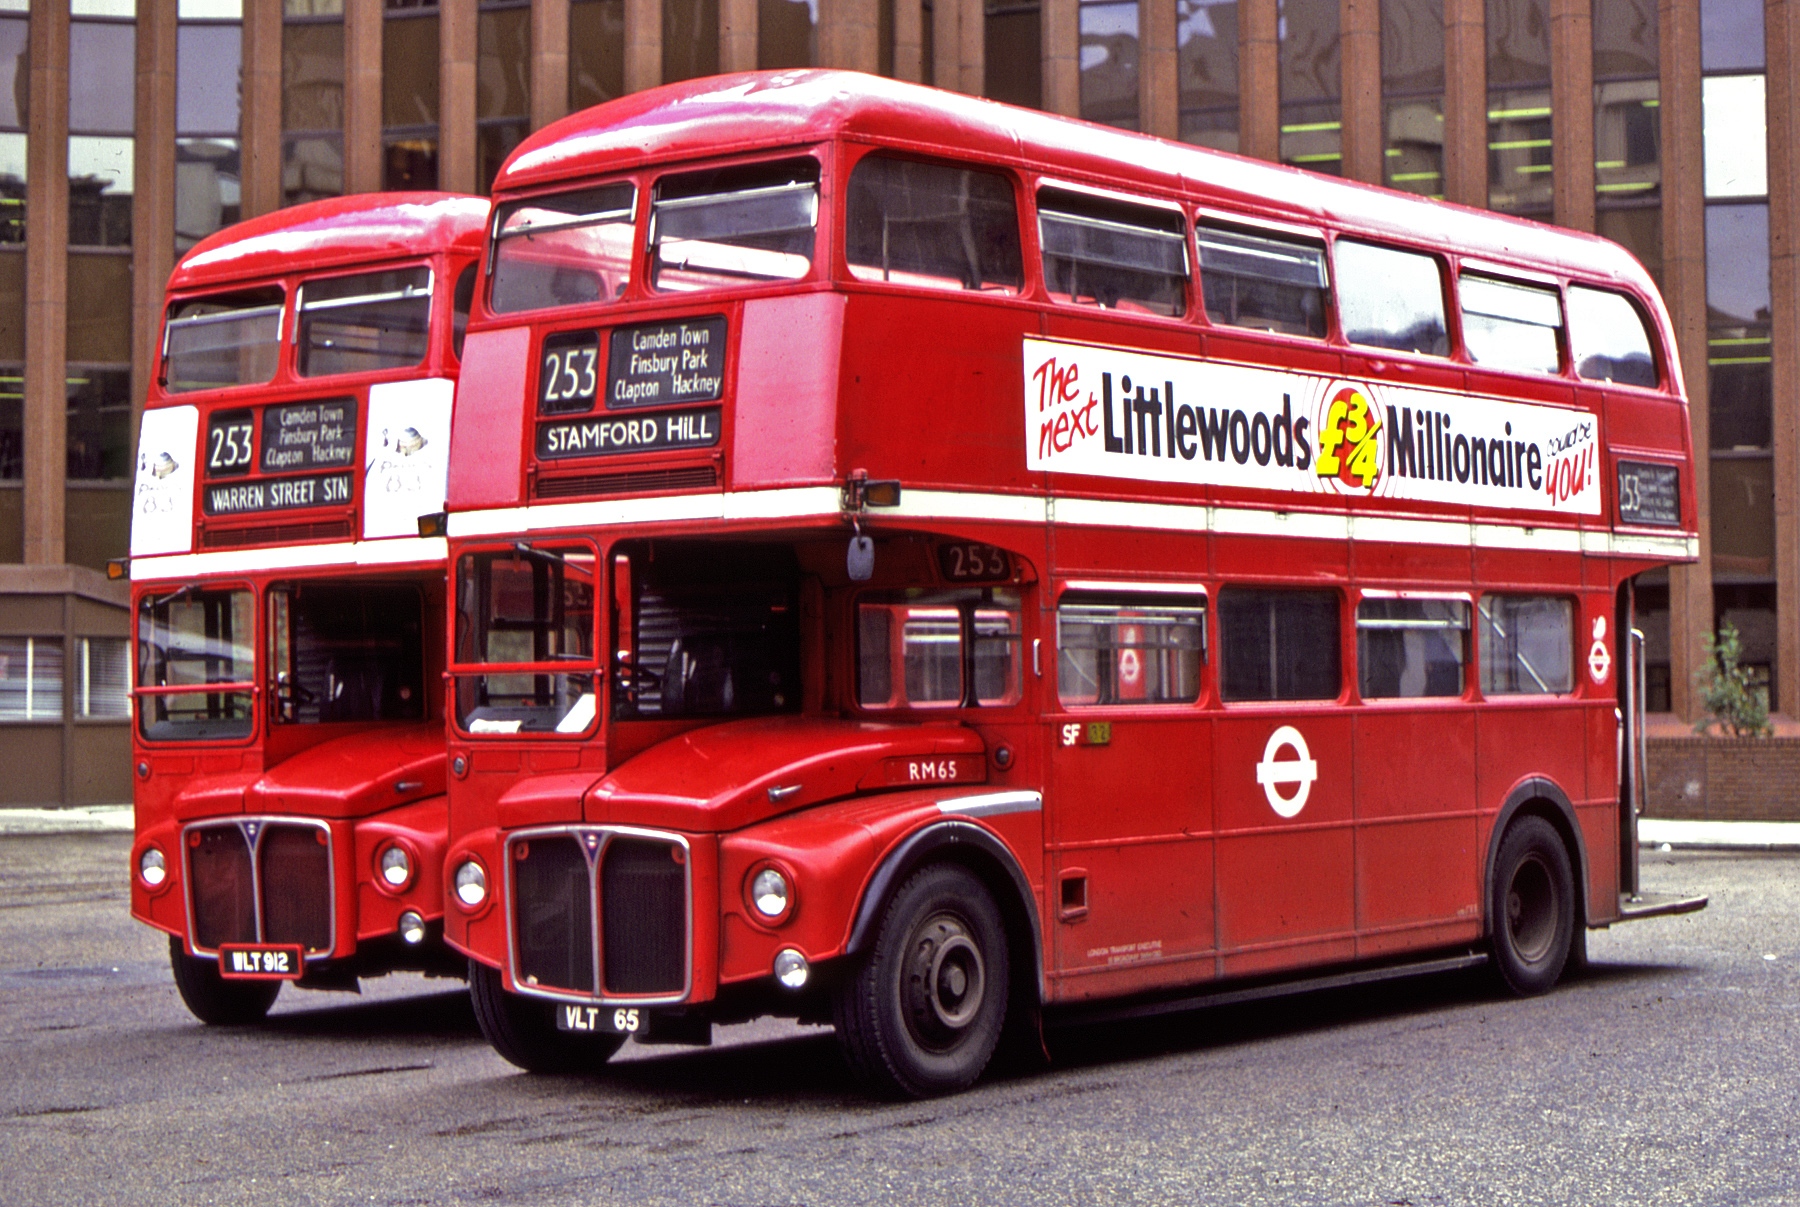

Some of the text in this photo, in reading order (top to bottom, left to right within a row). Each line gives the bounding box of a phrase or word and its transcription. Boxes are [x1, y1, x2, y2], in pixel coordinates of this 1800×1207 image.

[633, 325, 709, 351] Camden Town
[545, 348, 598, 401] 253
[630, 349, 708, 376] Finsbury Park
[614, 374, 721, 403] Clapton Hackney
[1033, 357, 1080, 412] The
[280, 405, 343, 427] Camden Town
[1039, 391, 1098, 460] next
[210, 424, 253, 467] 253
[279, 424, 343, 447] Finsbury Park
[548, 419, 658, 451] STAMFORD
[1102, 372, 1311, 471] Littlewoods
[1386, 405, 1542, 491] Millionaire
[265, 444, 353, 468] Clapton Hackney
[211, 485, 264, 512] WARREN
[270, 479, 316, 506] STREET
[323, 476, 348, 501] STN
[950, 545, 1004, 576] 253
[1063, 723, 1081, 746] SF
[232, 951, 289, 972] WLT 912
[566, 1005, 639, 1032] VLT 65
